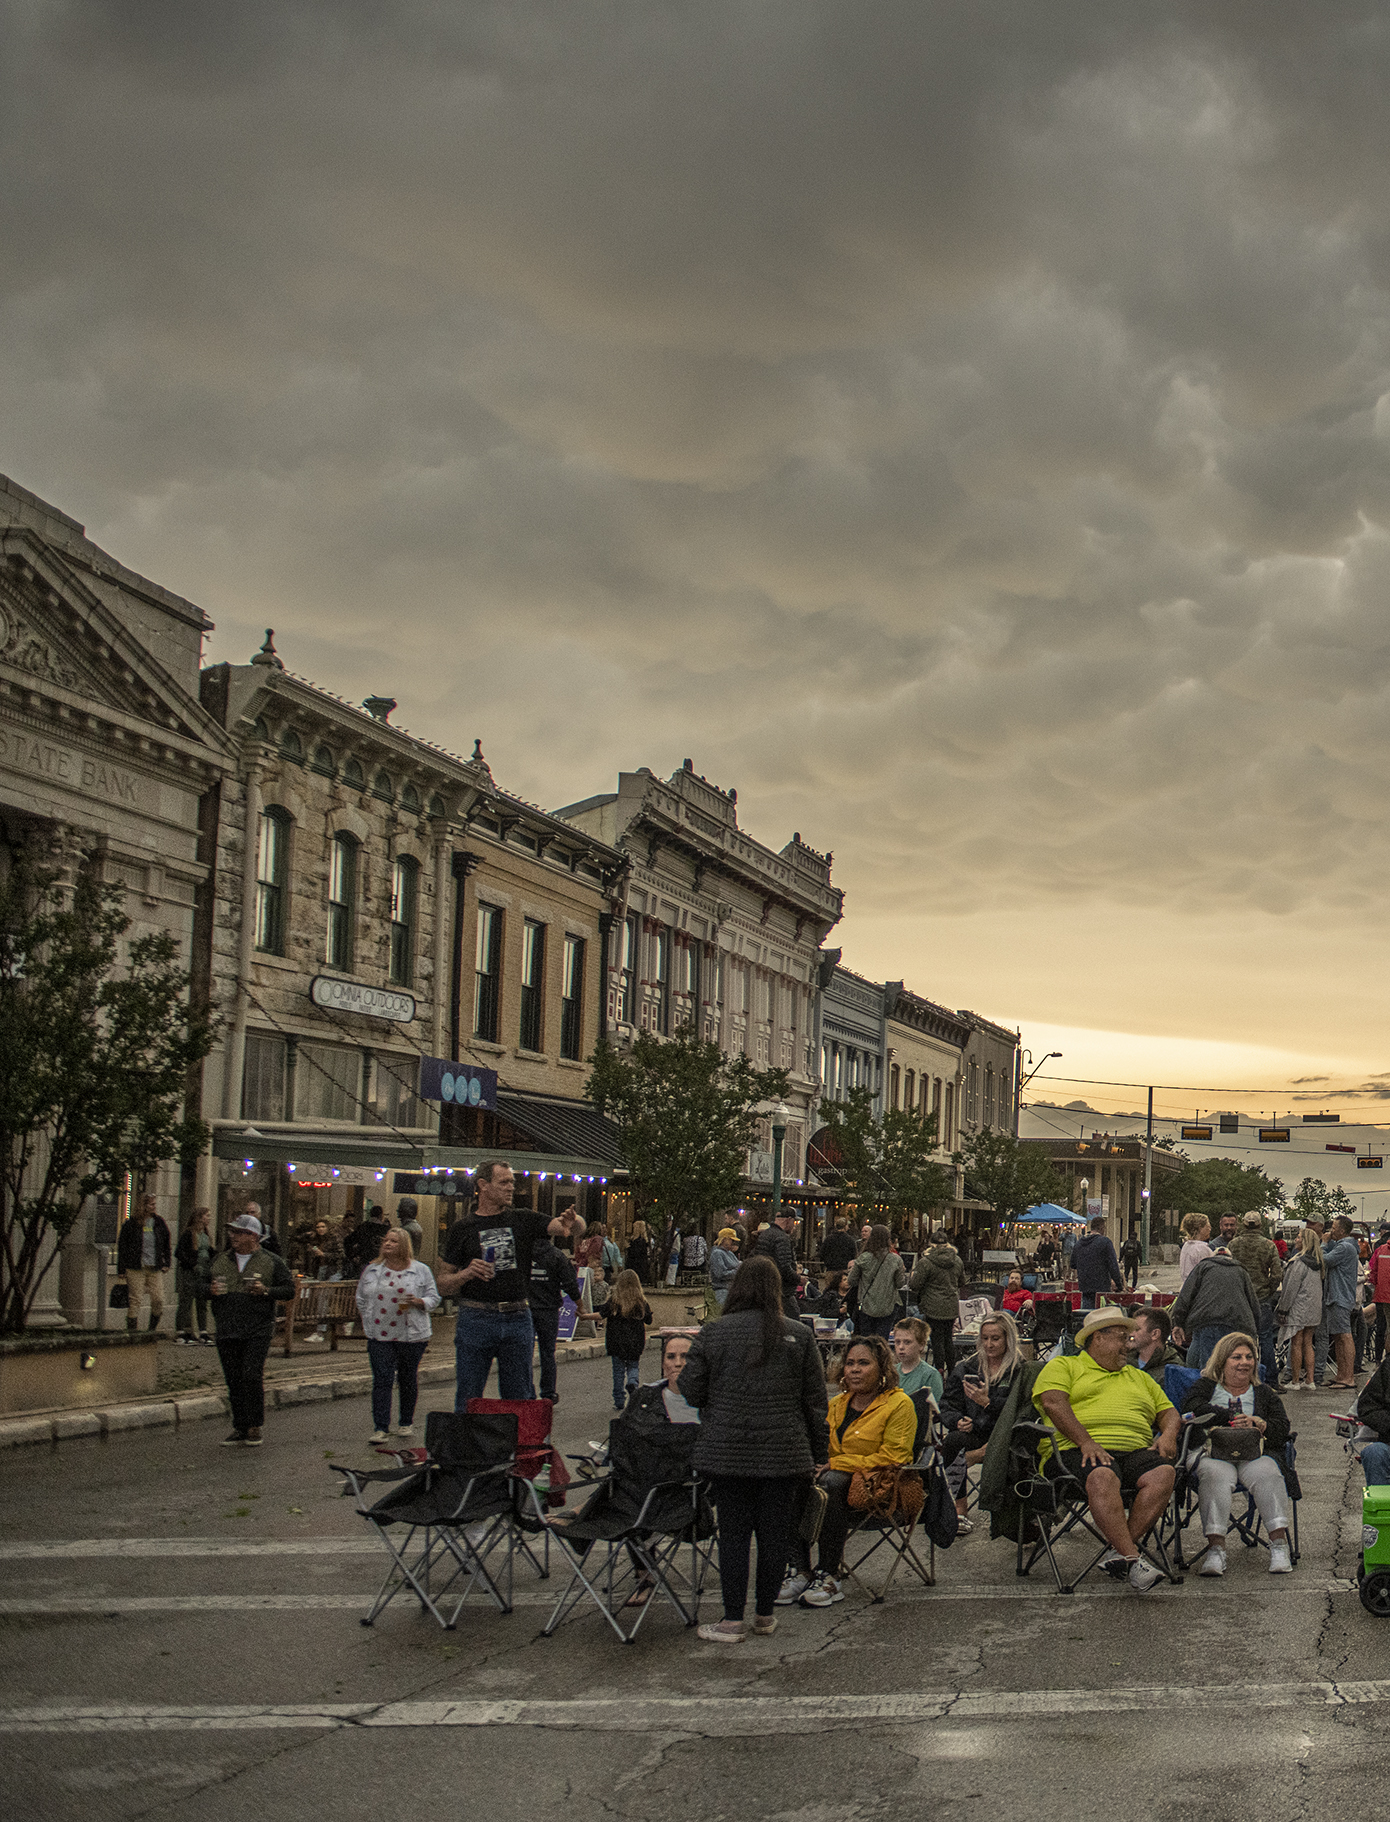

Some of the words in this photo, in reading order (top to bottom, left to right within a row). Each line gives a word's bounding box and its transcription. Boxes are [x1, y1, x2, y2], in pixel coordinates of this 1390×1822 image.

[0, 730, 70, 779] STATE
[82, 760, 138, 802] BANK
[333, 983, 361, 1003] OMNIA
[364, 990, 409, 1013] OUTDOORS
[818, 1168, 858, 1176] gastrop
